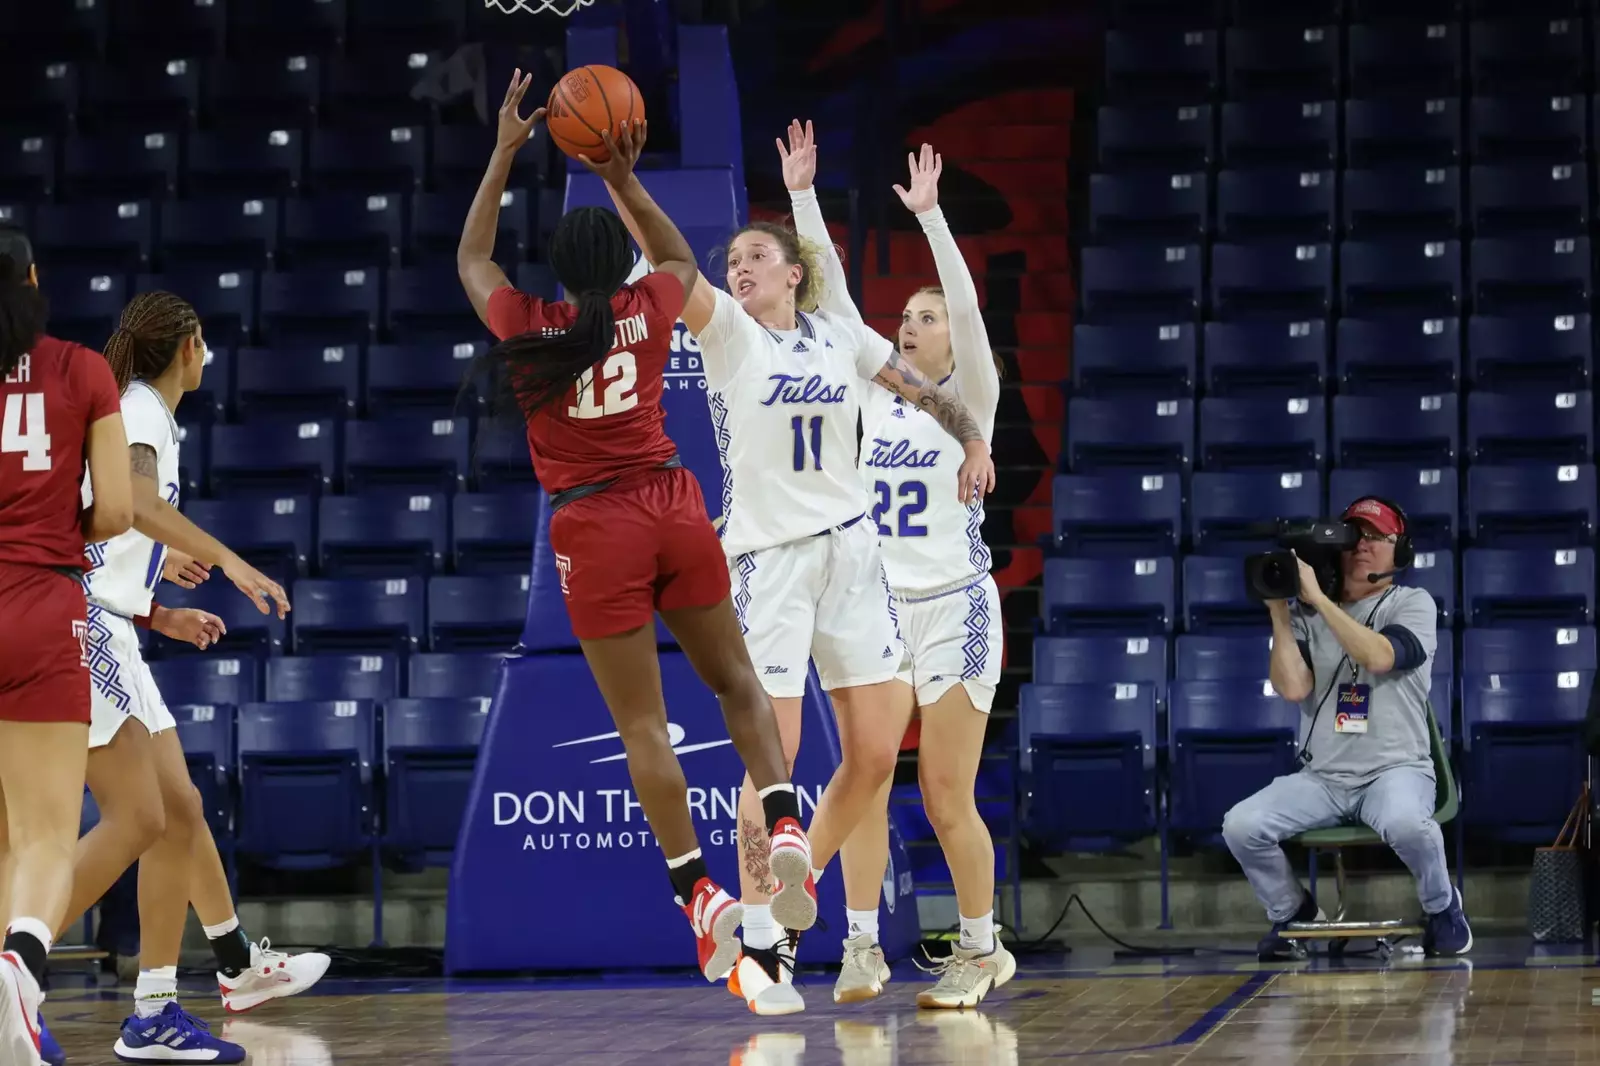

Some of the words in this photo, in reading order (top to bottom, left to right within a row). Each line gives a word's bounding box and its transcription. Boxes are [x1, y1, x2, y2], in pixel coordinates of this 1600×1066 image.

[568, 351, 638, 419] 12
[761, 374, 847, 407] Tulsa
[791, 415, 823, 472] 11
[865, 438, 940, 468] Tulsa
[871, 480, 928, 537] 22
[493, 790, 585, 825] DON
[596, 784, 822, 823] THRNN
